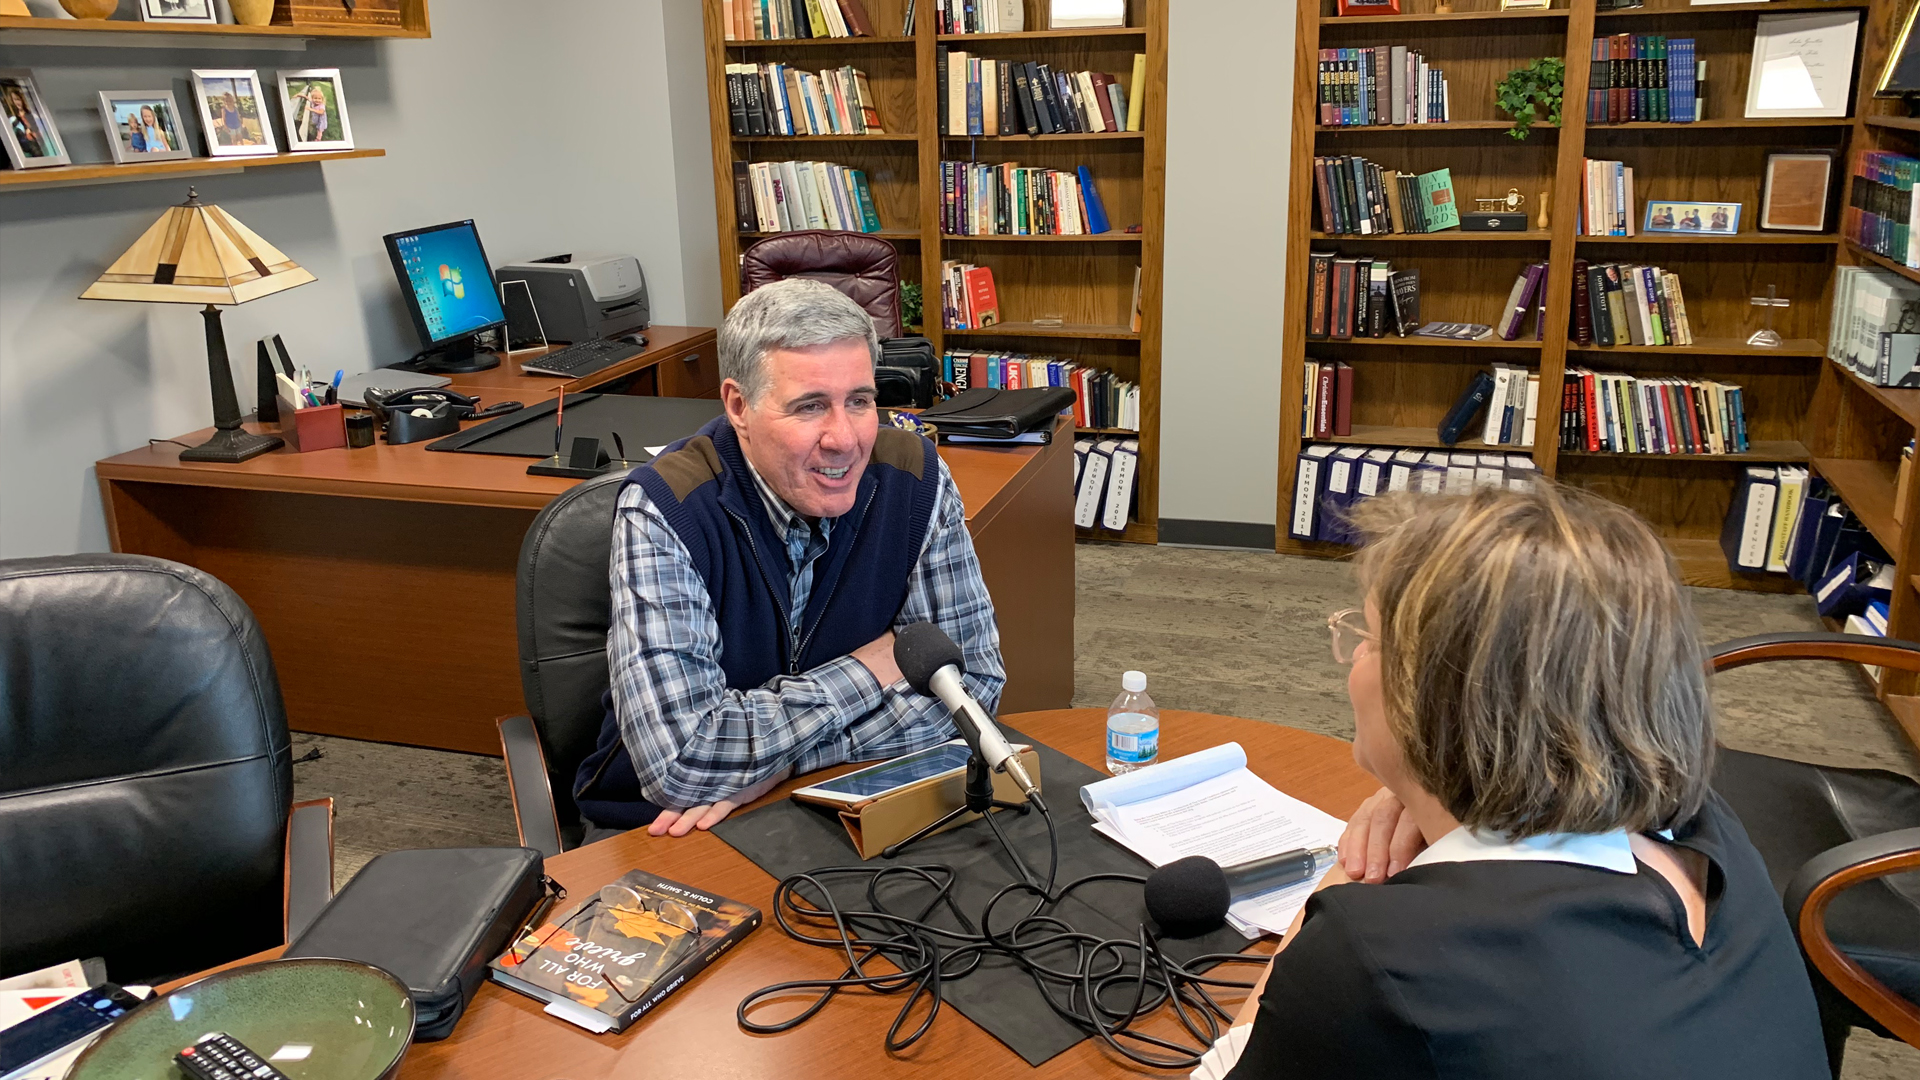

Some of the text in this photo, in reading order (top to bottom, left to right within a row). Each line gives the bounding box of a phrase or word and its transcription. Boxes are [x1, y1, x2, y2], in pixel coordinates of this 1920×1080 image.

[946, 163, 954, 176] THE
[773, 179, 784, 204] PAUL
[1009, 365, 1018, 380] UK
[1117, 455, 1127, 496] SERMONS
[1302, 461, 1312, 505] SERMONS
[1080, 456, 1100, 524] SERMONS 2009
[1784, 488, 1794, 522] HANDBOOK
[1748, 486, 1766, 564] CONFERENCES
[657, 883, 682, 893] SMITH
[690, 893, 713, 904] COLIN
[564, 953, 605, 974] WHO
[565, 938, 646, 966] grieve
[539, 960, 603, 989] FOR ALL
[630, 1009, 642, 1020] FOR
[642, 1001, 652, 1011] ALL
[652, 990, 666, 1002] WHO
[666, 975, 685, 993] GRIEVE
